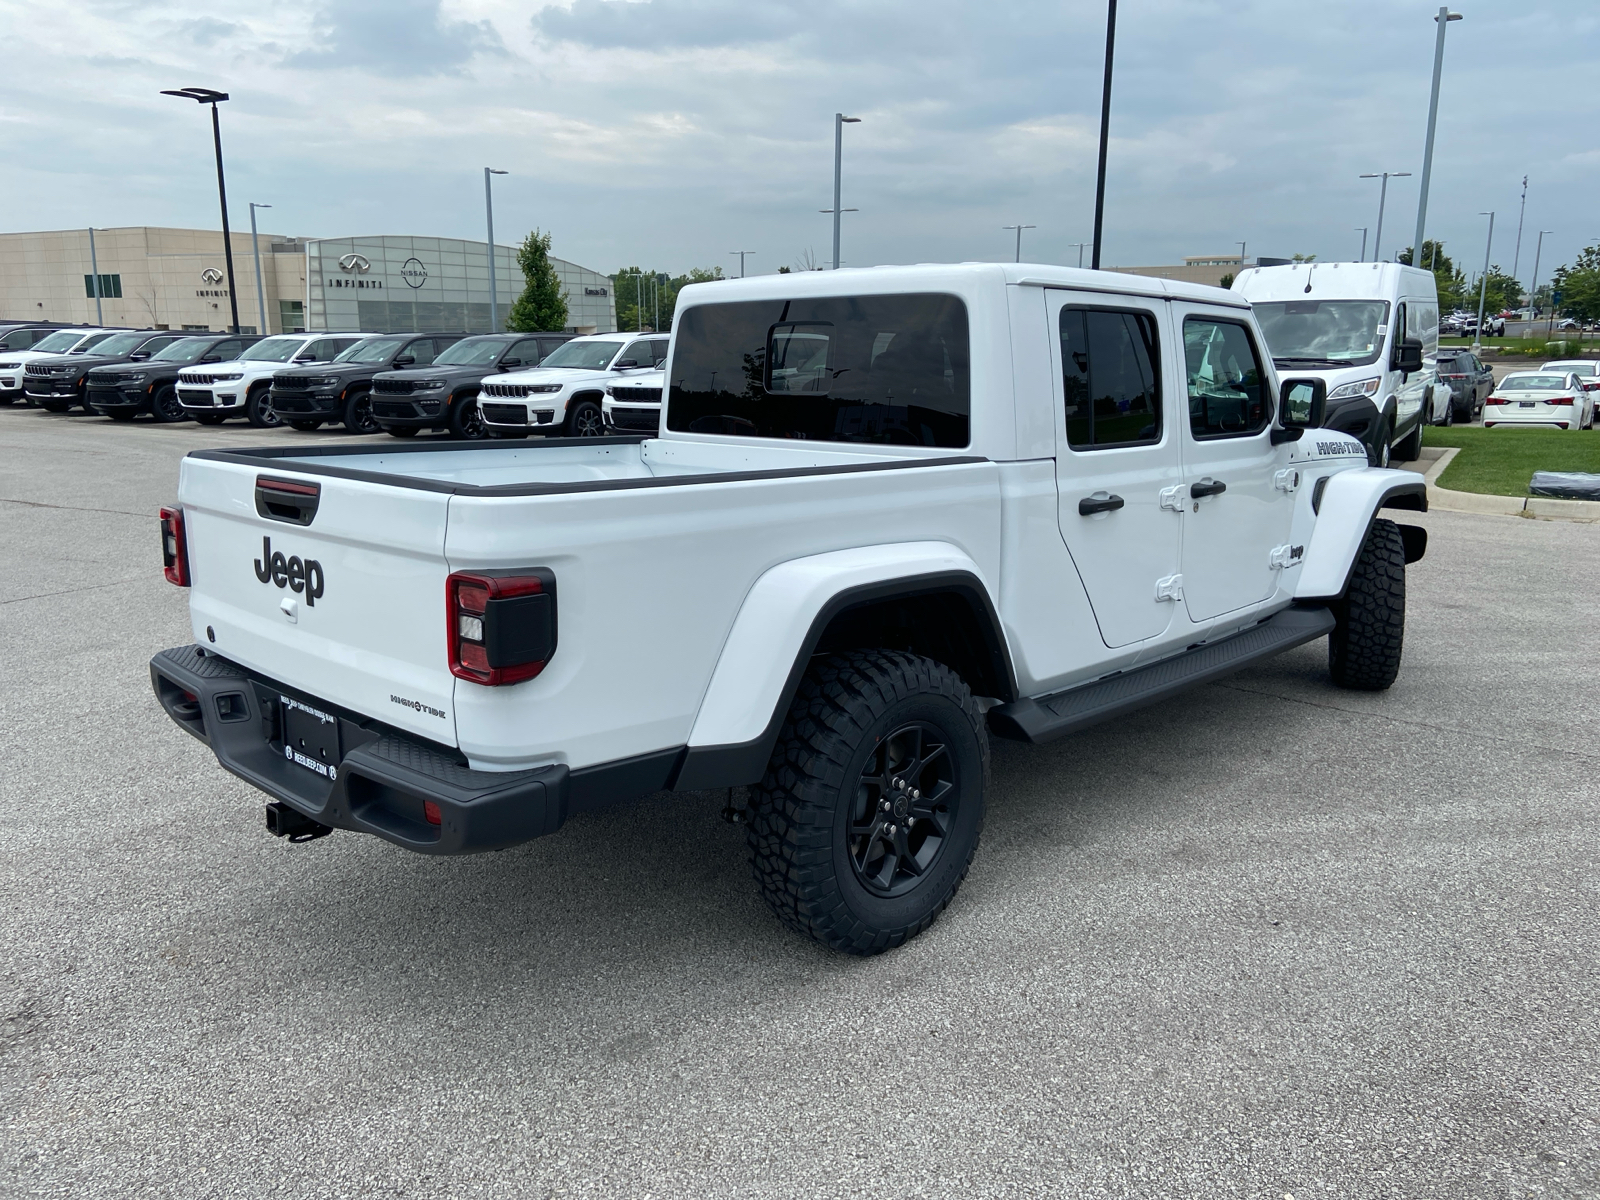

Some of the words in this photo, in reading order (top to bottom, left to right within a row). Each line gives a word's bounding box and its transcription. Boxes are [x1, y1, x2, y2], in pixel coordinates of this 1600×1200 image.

[329, 279, 382, 289] INFINITI
[253, 535, 325, 608] Jeep
[421, 703, 446, 719] TIDE
